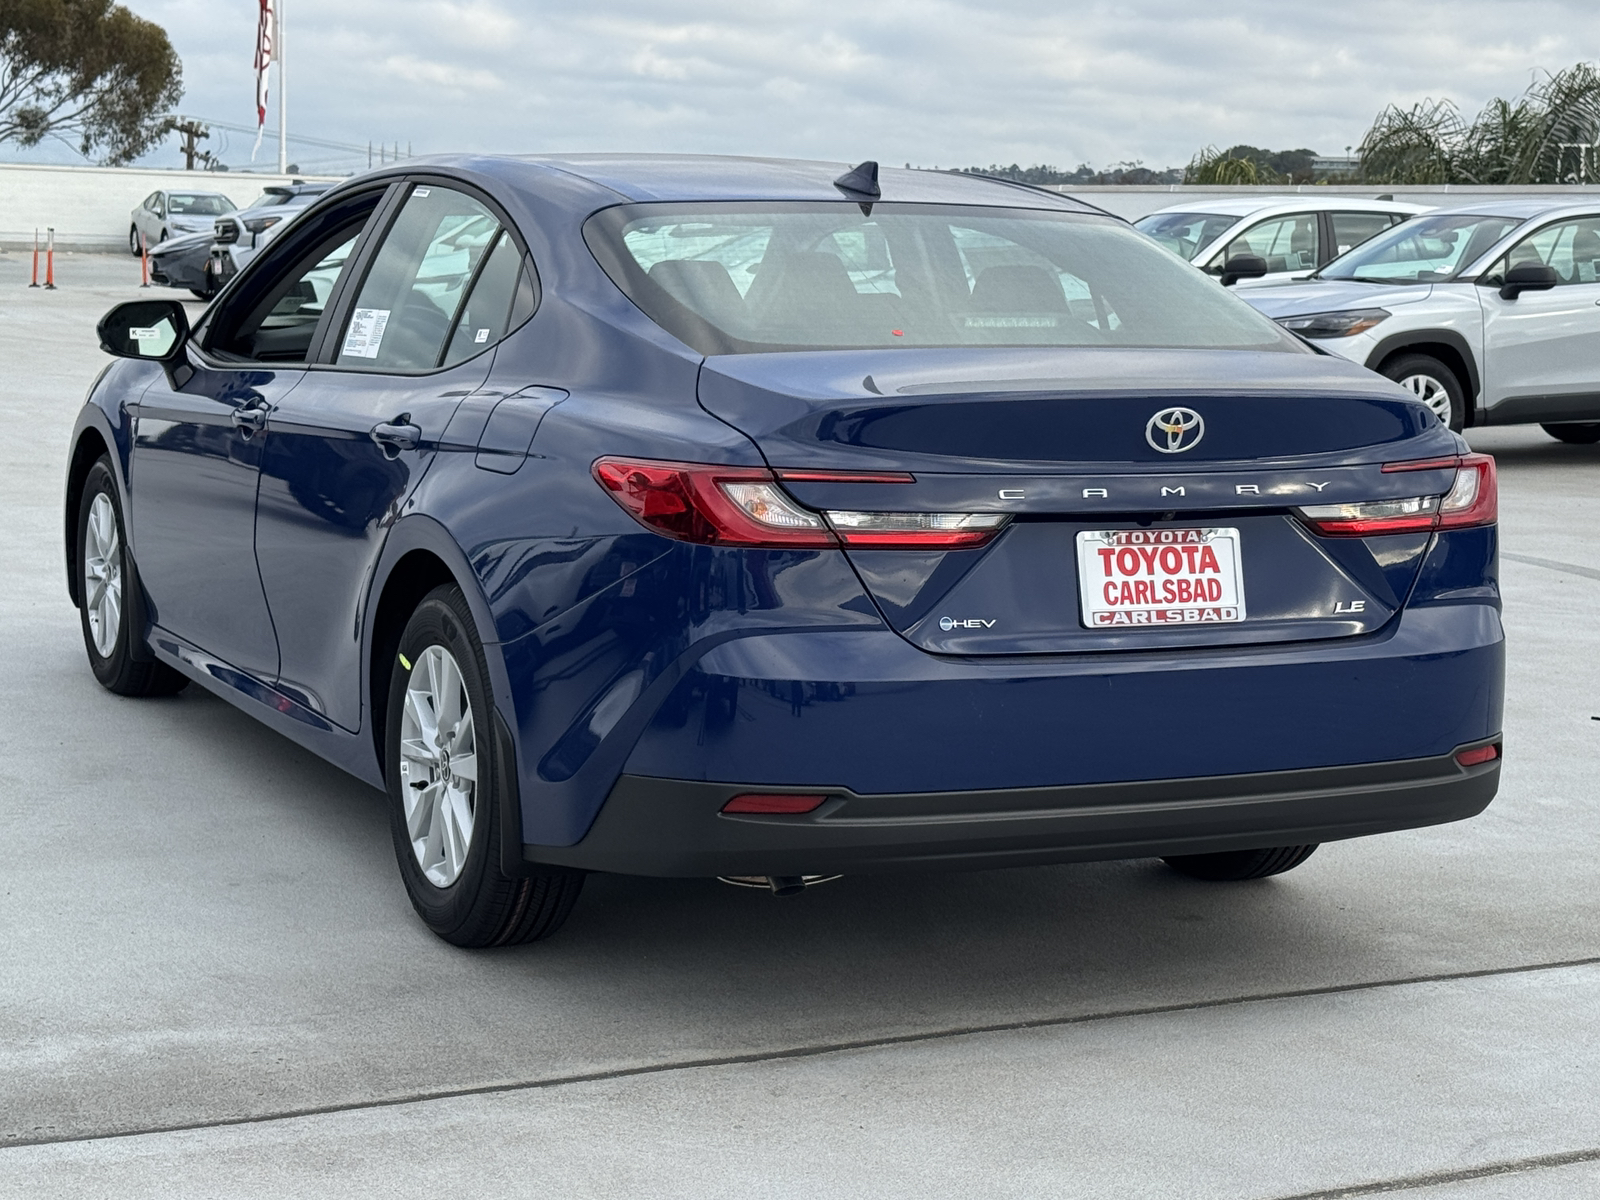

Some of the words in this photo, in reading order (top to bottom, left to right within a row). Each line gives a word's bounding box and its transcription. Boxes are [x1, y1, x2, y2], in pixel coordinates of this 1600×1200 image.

[998, 481, 1331, 500] CAMRY
[1120, 531, 1200, 544] TOYOTA
[1097, 545, 1221, 577] TOYOTA
[1103, 578, 1222, 606] CARLSBAD
[1093, 607, 1238, 625] CARLSBAD
[1334, 600, 1366, 614] LE
[953, 619, 996, 628] HEV
